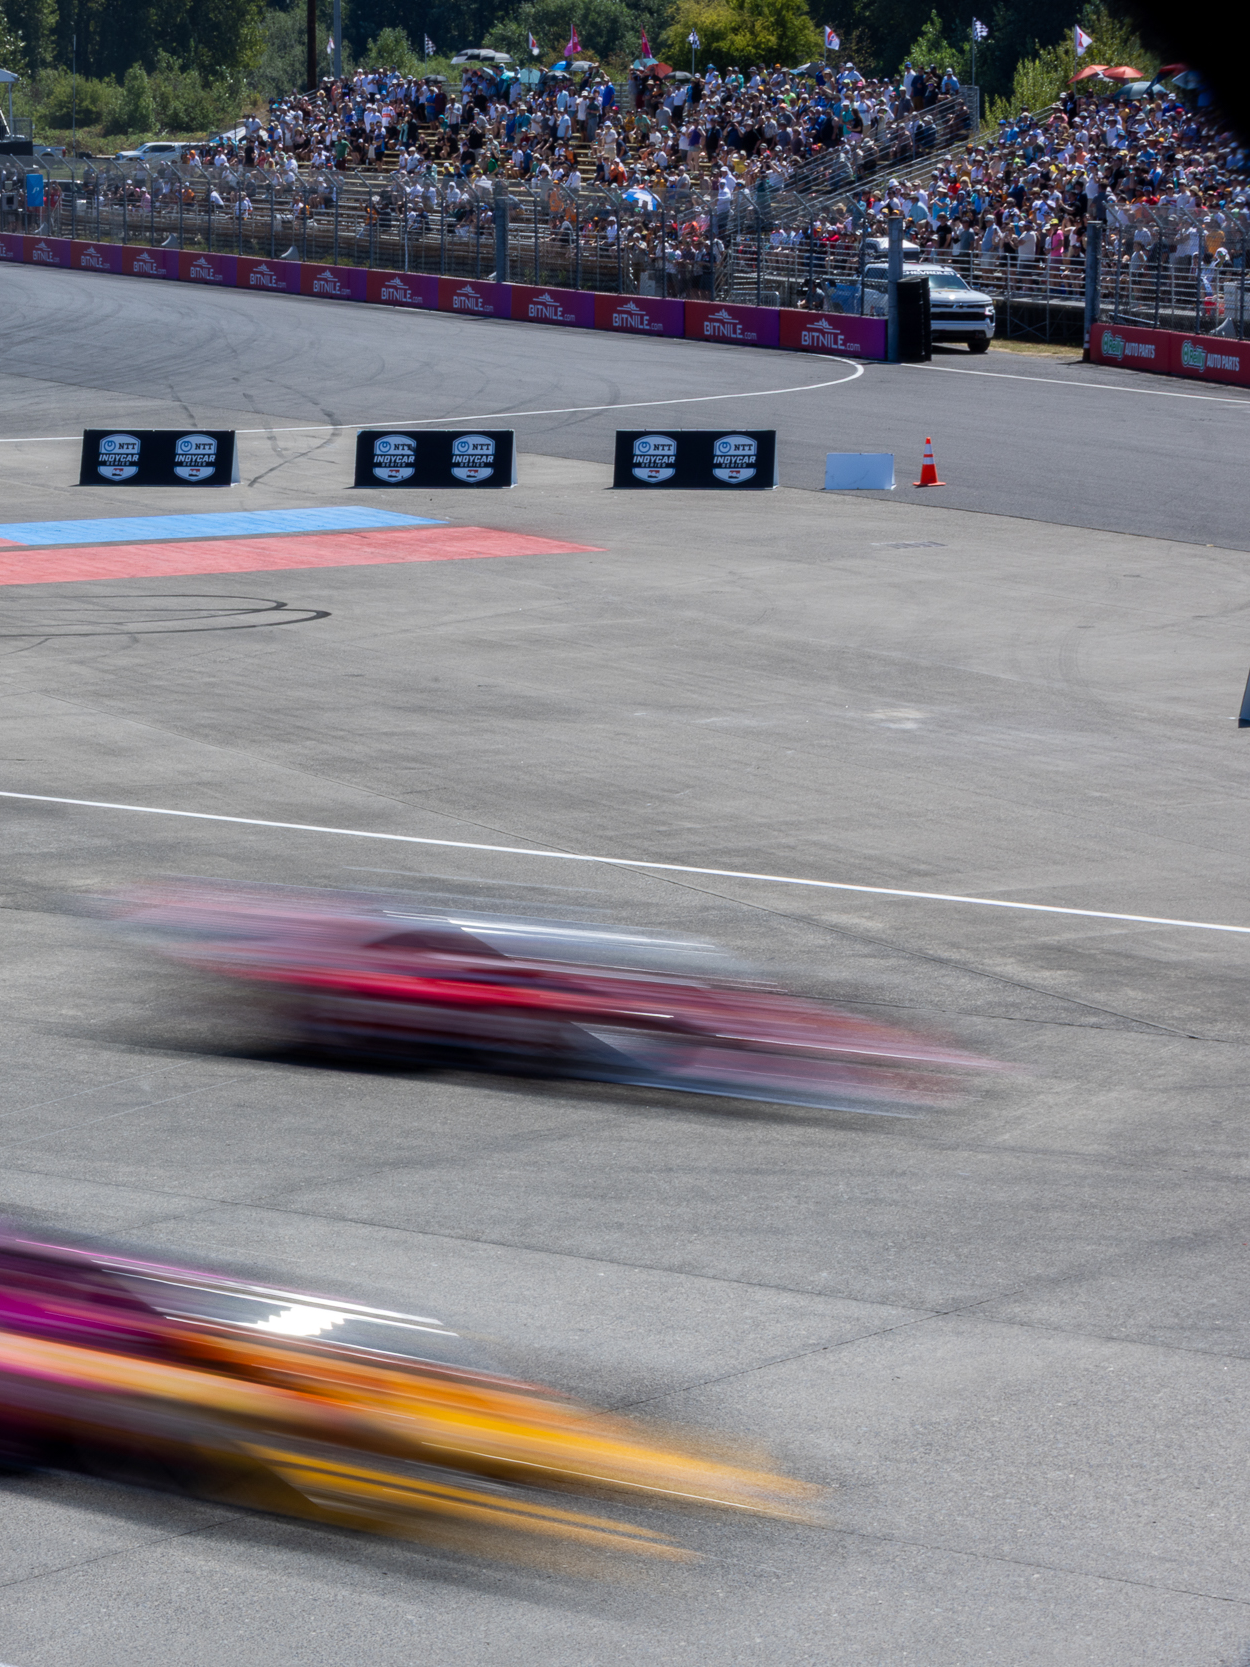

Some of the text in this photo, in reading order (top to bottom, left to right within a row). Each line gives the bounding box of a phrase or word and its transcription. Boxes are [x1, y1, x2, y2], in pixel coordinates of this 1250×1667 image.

[33, 251, 60, 262] BITNILE.com
[81, 256, 110, 268] BITNILE.com
[134, 262, 166, 274] BITNILE.com
[191, 267, 223, 280] BITNILE.com
[250, 274, 286, 288] BITNILE.com
[313, 281, 351, 295] BITNILE.com
[381, 288, 422, 303] BITNILE.com
[453, 296, 494, 312] BITNILE.com
[528, 305, 575, 321] BITNILE.com
[613, 314, 663, 330] BITNILE.com
[704, 322, 757, 340] BITNILE.com
[802, 331, 861, 351] BITNILE.com
[1125, 343, 1138, 356] AUTO
[1139, 344, 1155, 358] PARTS
[1207, 354, 1220, 368] AUTO
[1222, 355, 1239, 371] PARTS
